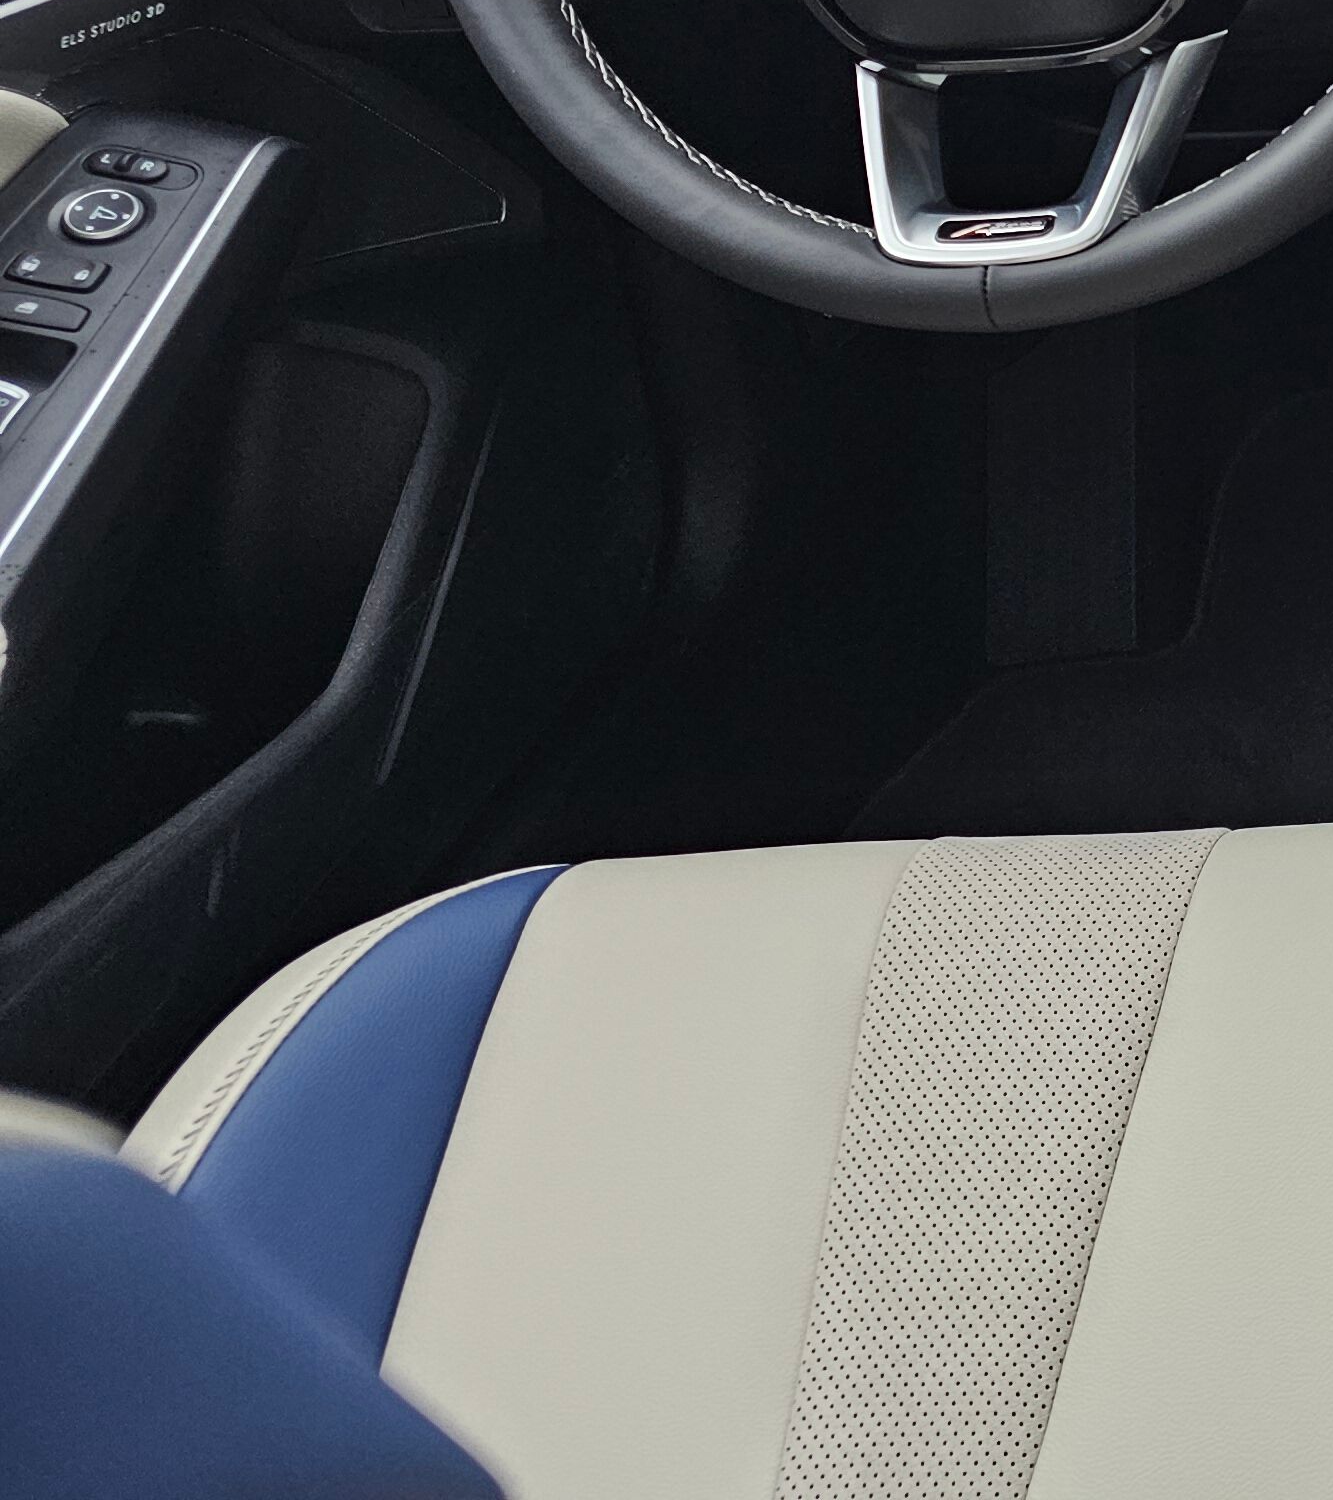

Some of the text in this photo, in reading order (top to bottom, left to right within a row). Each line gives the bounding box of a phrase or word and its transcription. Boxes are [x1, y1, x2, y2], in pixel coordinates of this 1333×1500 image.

[60, 2, 165, 49] ELS STUDIO 3D
[140, 161, 155, 172] R
